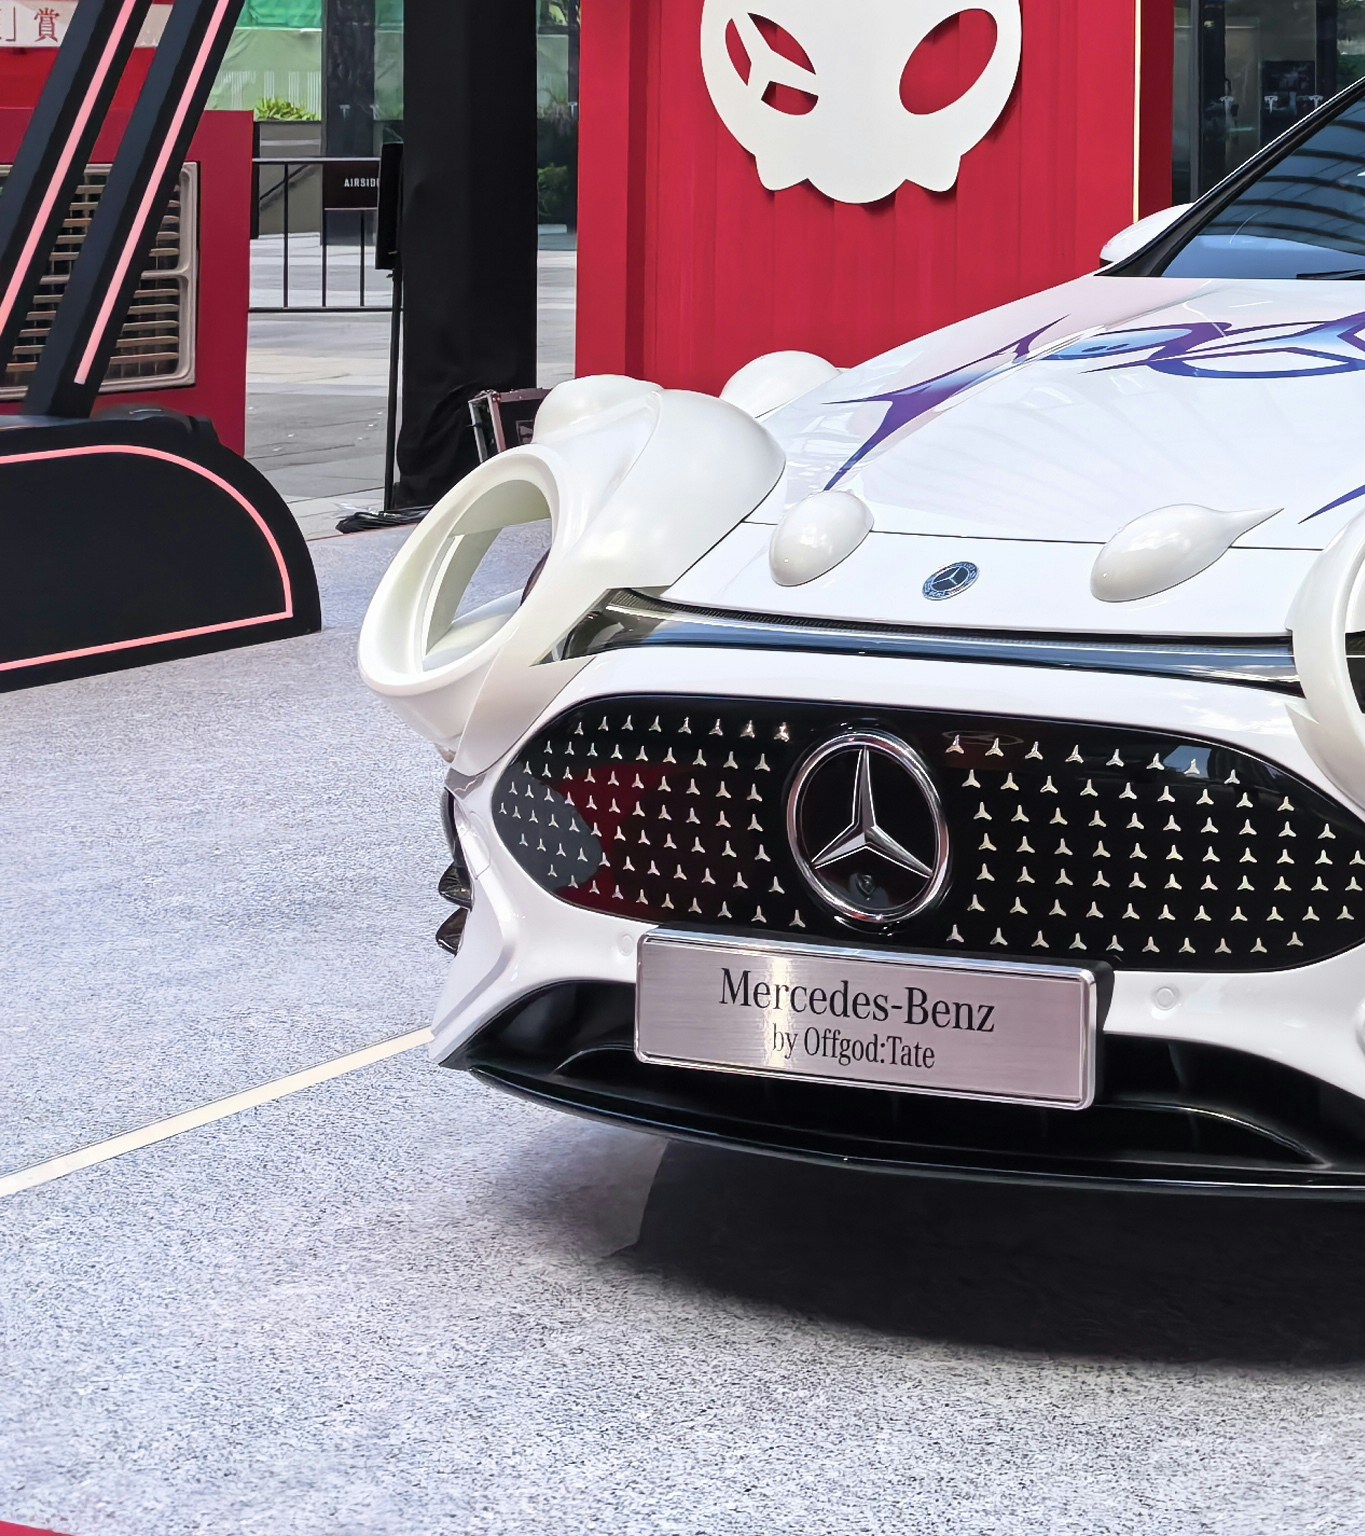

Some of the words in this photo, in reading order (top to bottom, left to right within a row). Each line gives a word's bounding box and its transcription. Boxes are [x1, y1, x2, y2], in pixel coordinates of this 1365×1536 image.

[719, 967, 996, 1033] Mercedes-Benz
[772, 1023, 798, 1059] by
[804, 1026, 936, 1068] Offgod:Tate
